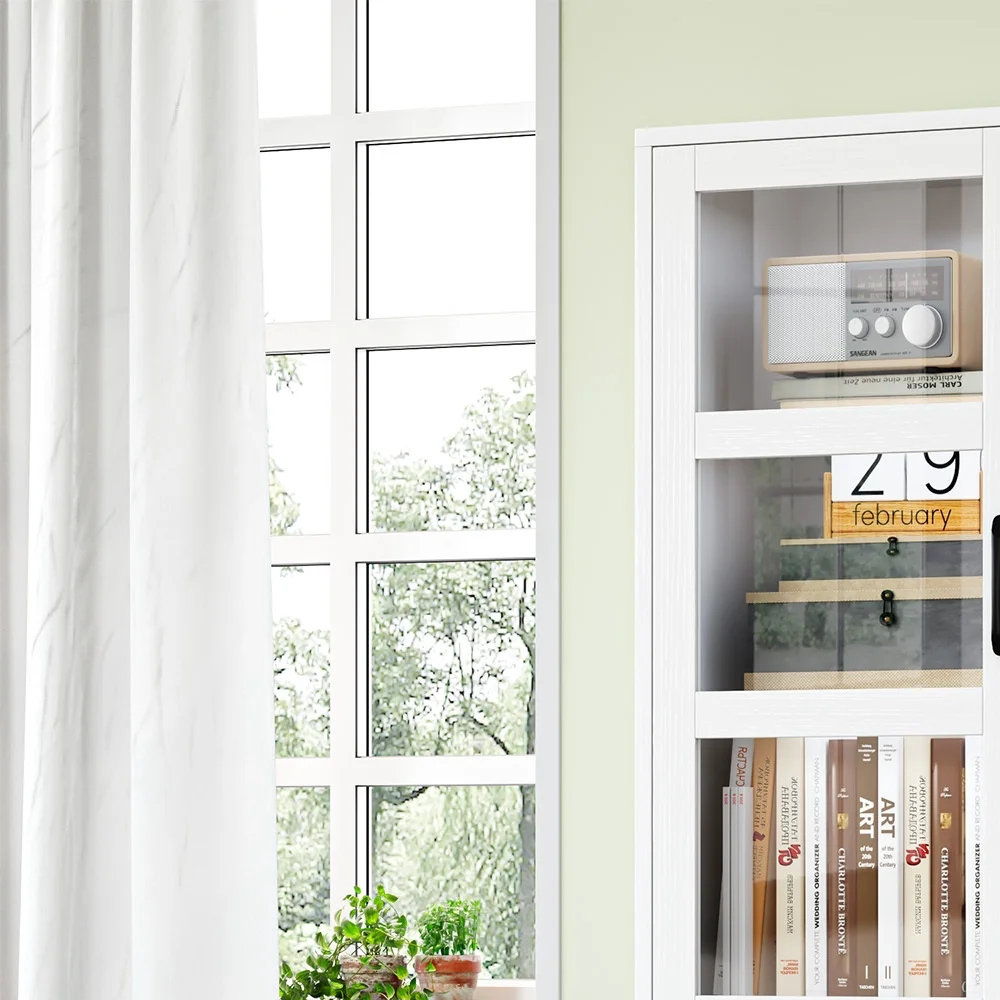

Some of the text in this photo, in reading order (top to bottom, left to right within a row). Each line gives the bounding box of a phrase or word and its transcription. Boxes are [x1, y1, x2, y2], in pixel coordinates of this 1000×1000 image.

[907, 382, 936, 390] MOSER
[918, 374, 962, 382] Architektur
[853, 503, 952, 531] february
[860, 796, 874, 838] ART
[880, 797, 895, 838] ART
[858, 861, 875, 869] Century
[838, 848, 846, 911] CHARLOTTE
